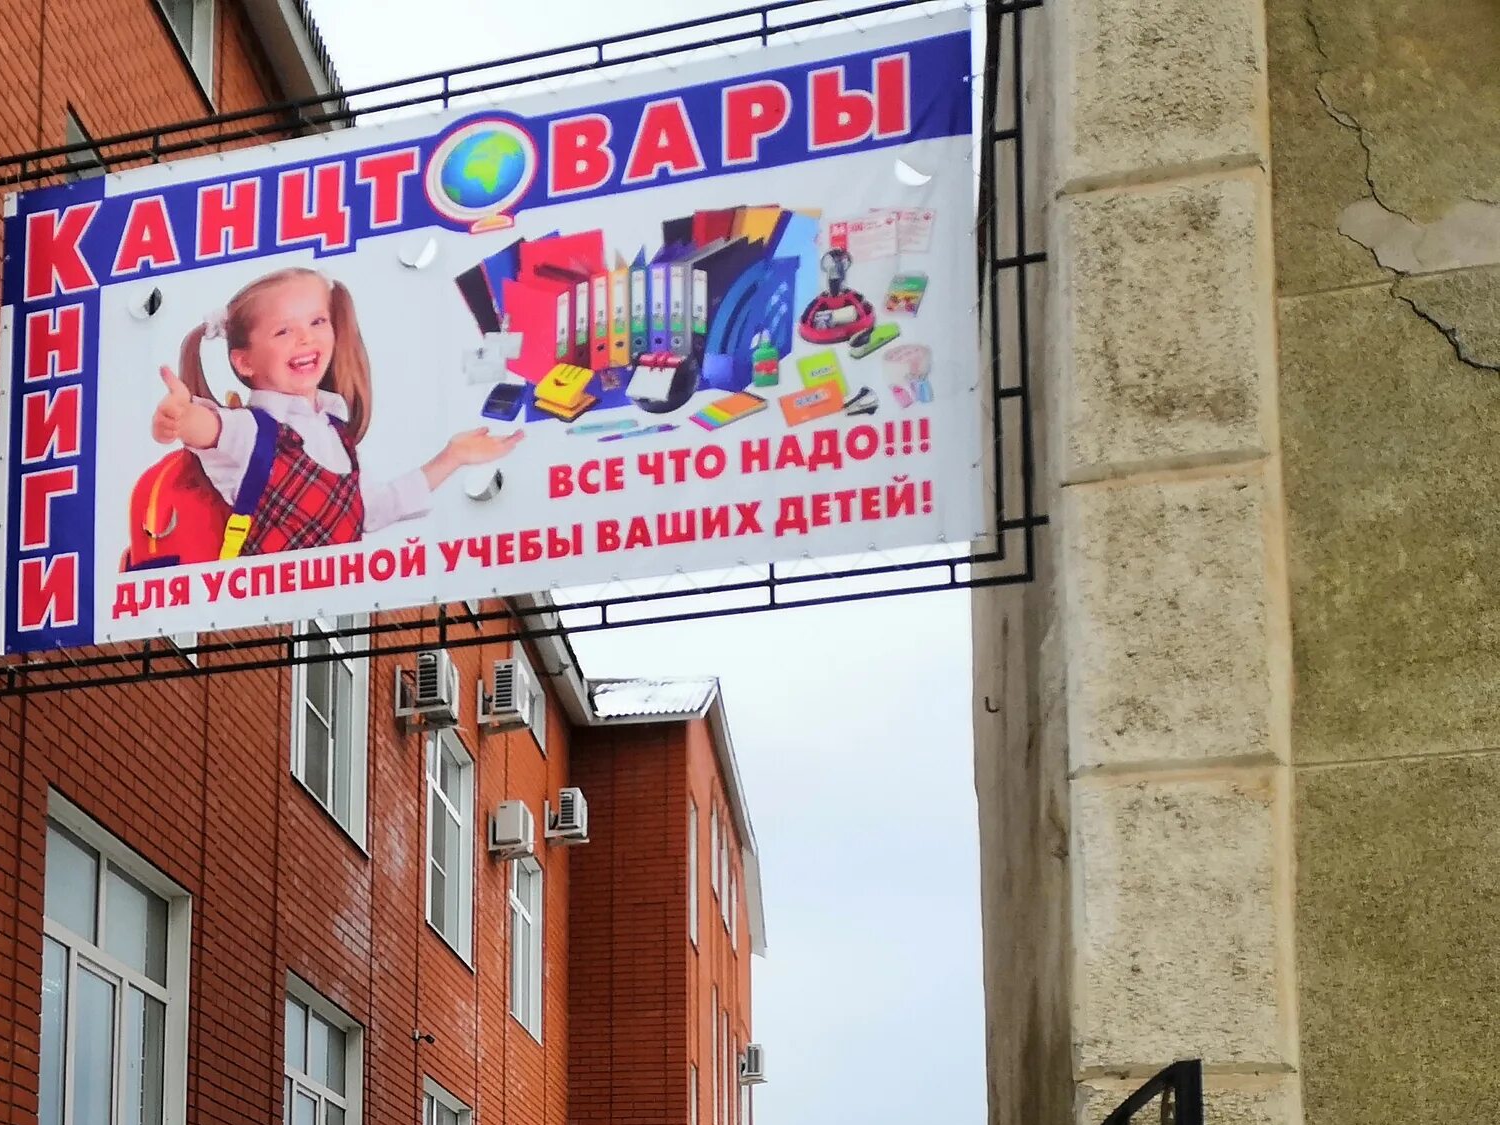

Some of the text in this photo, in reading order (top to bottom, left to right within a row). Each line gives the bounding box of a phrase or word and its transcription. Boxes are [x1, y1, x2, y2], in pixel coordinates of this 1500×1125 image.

[17, 201, 101, 632] КНИГИ
[548, 417, 931, 499] ВСЕ ЧТО НАДО!!!
[112, 474, 932, 620] ДЛЯ УСПЕШНОЙ УЧЕБЫ ВАШИХ ДЕТЕЙ!
